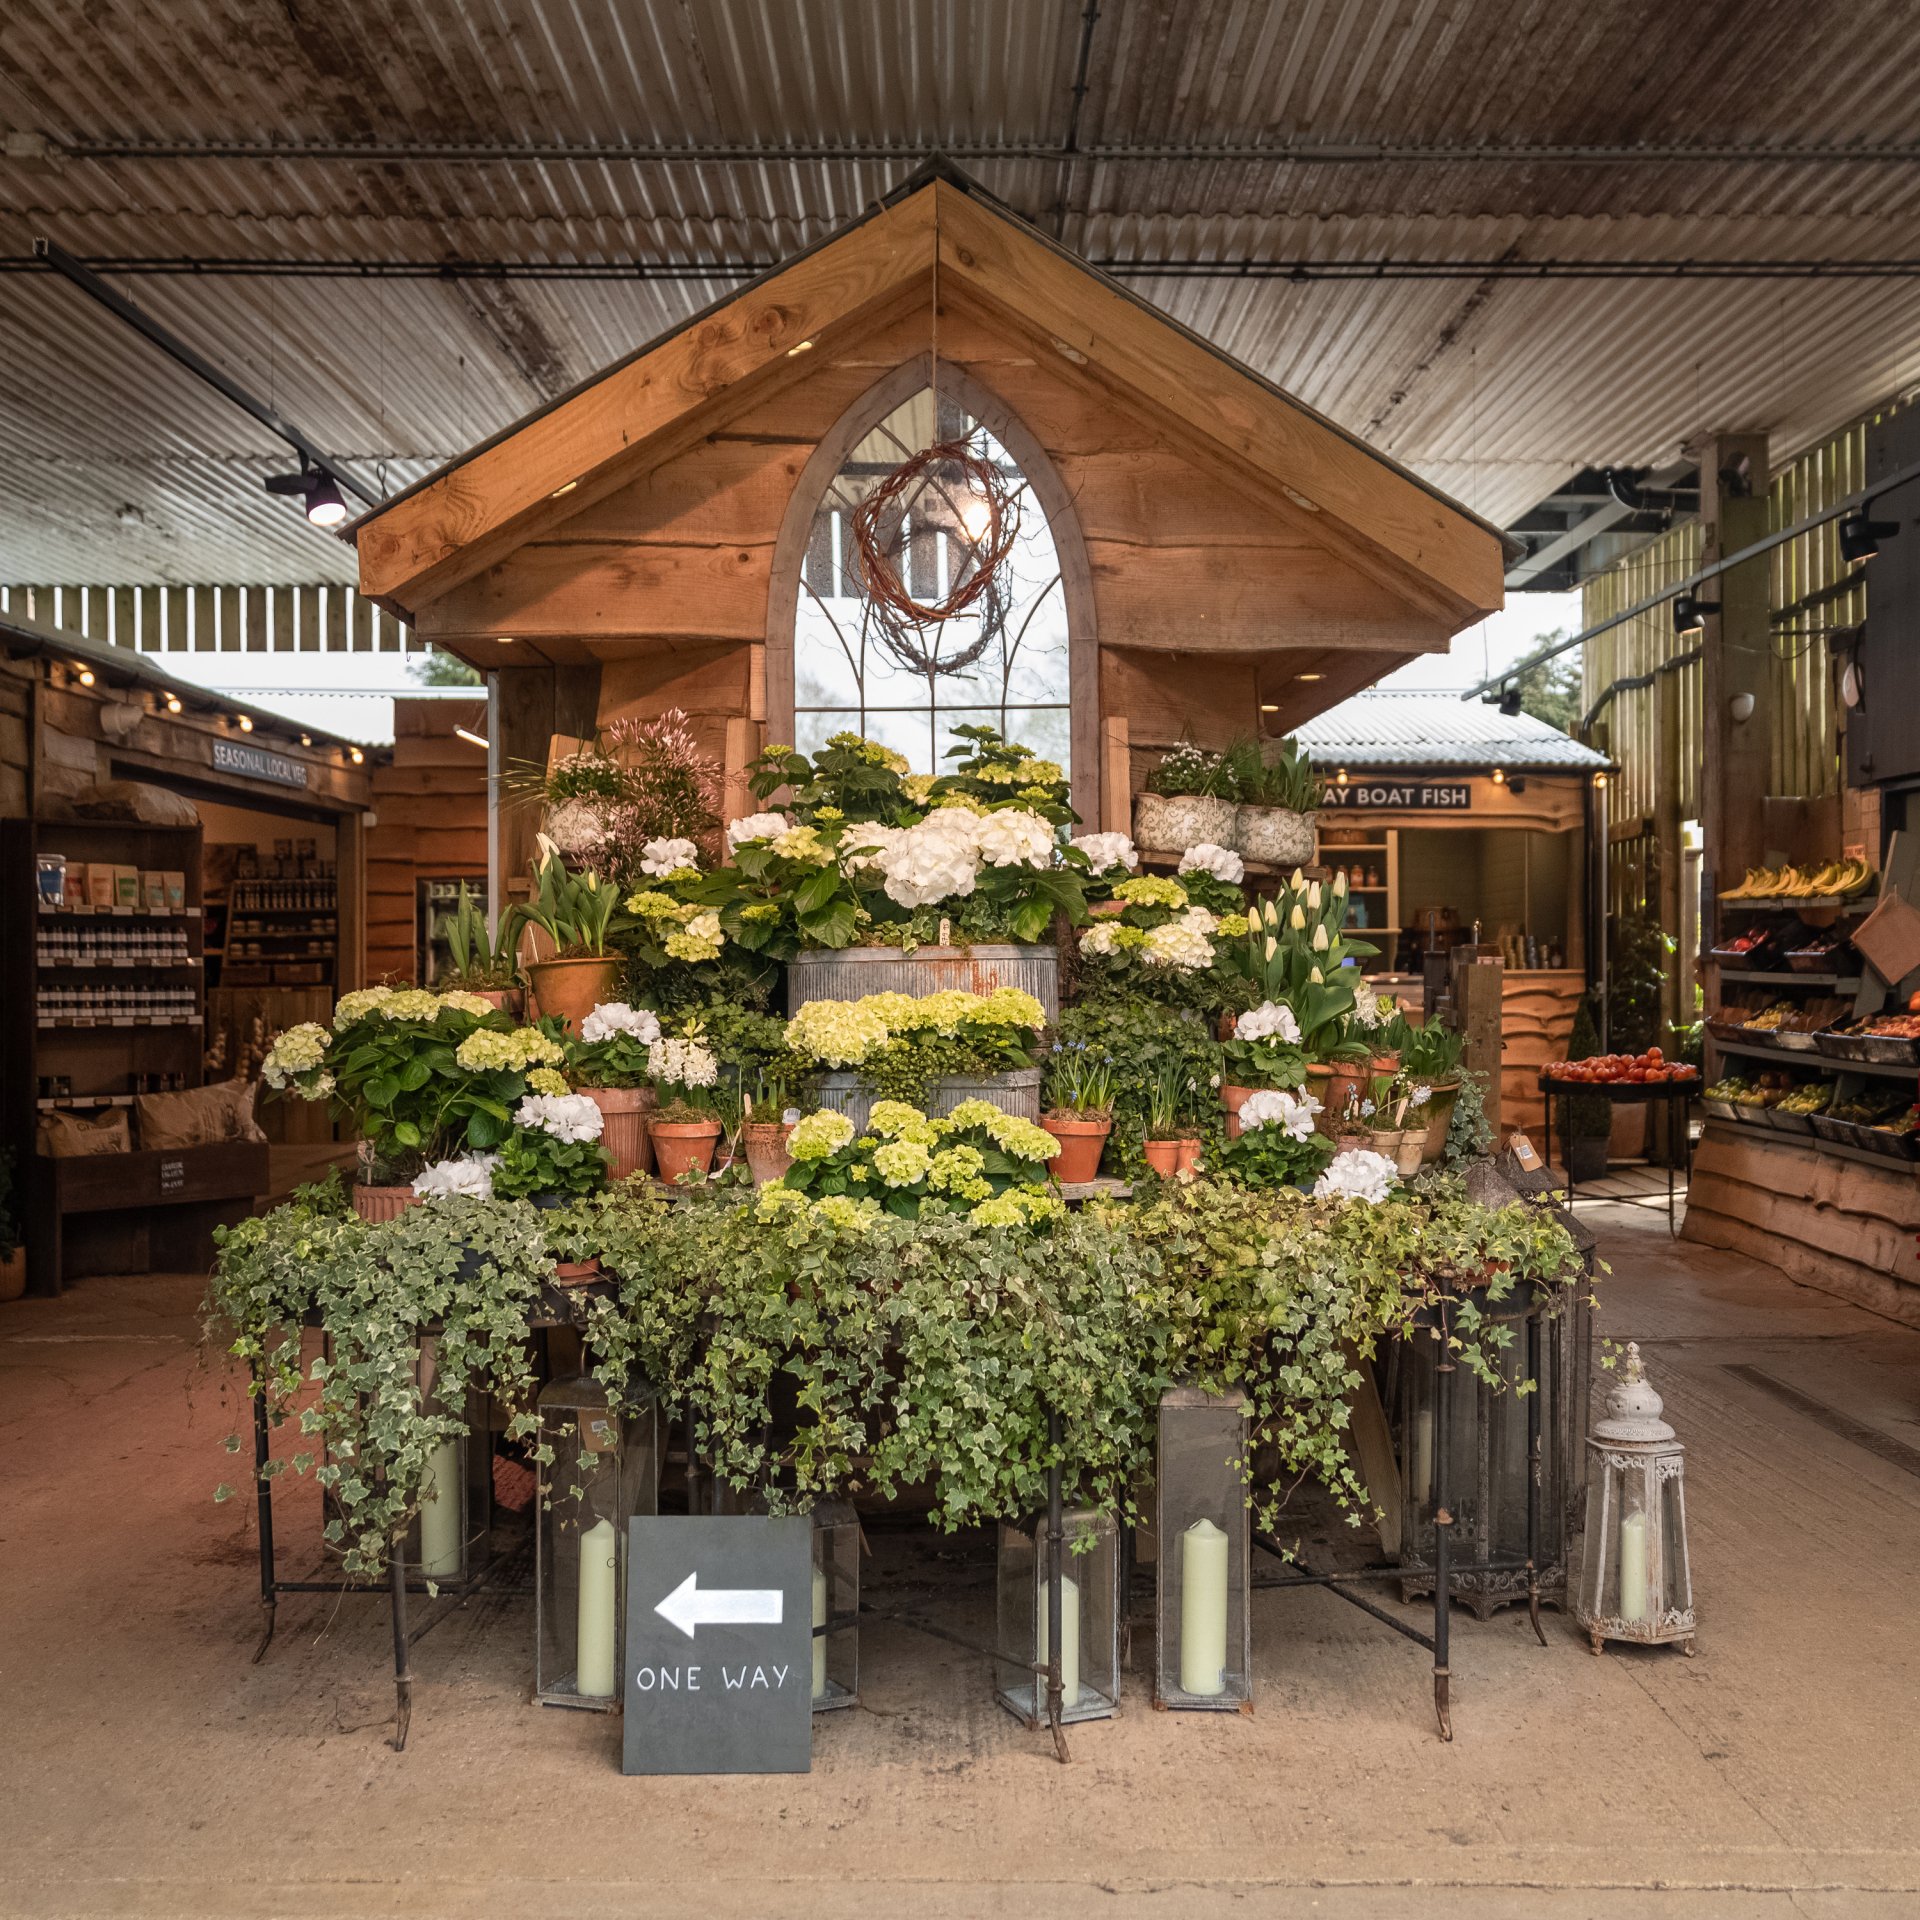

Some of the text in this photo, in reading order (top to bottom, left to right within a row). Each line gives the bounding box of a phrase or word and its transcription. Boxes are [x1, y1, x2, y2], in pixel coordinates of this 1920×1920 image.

[214, 744, 264, 773] SEASONAL
[266, 757, 292, 780] LOCAL
[1322, 788, 1467, 805] AY BOAT FISH
[636, 1664, 789, 1691] ONE WAY
